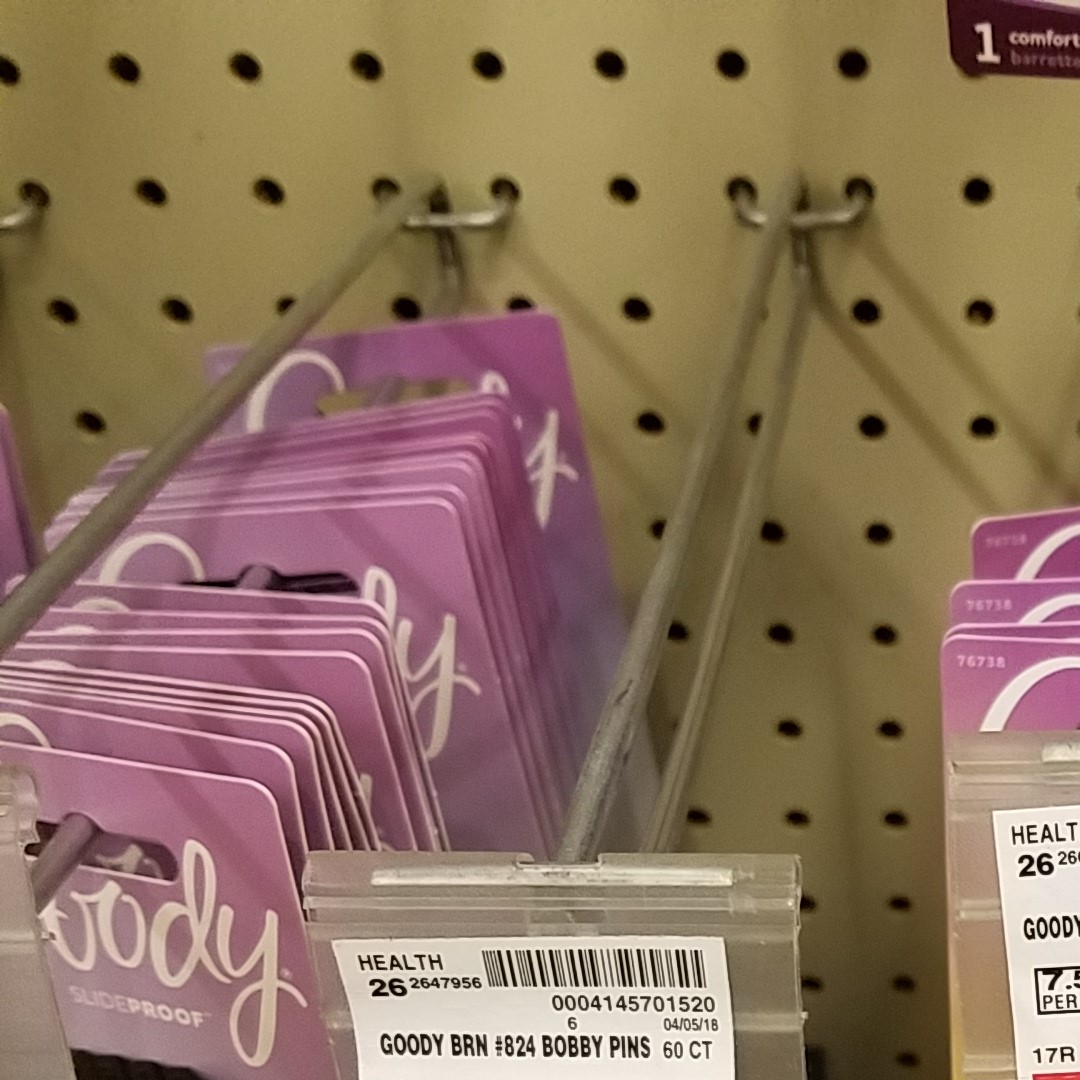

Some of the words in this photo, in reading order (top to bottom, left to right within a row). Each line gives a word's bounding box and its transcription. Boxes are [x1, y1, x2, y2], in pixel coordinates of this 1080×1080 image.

[974, 22, 1001, 64] 1
[956, 655, 1006, 668] 76738
[1018, 852, 1054, 878] 26
[38, 838, 307, 1068] oody
[358, 954, 444, 972] HEALTH
[368, 978, 408, 998] 26
[410, 976, 482, 990] 2647956
[68, 986, 206, 1029] SLIDEPROOF
[552, 994, 716, 1013] 0004145701520
[1042, 994, 1078, 1010] PER
[568, 1016, 578, 1031] 6
[663, 1018, 719, 1032] 04/05/18
[380, 1034, 444, 1058] GOODY
[450, 1034, 488, 1058] BRN
[495, 1035, 536, 1058] #824
[542, 1035, 603, 1059] BOBBY
[609, 1036, 652, 1060] PINS
[662, 1040, 682, 1060] 60
[689, 1040, 713, 1060] CT
[1032, 1046, 1076, 1064] 17R
